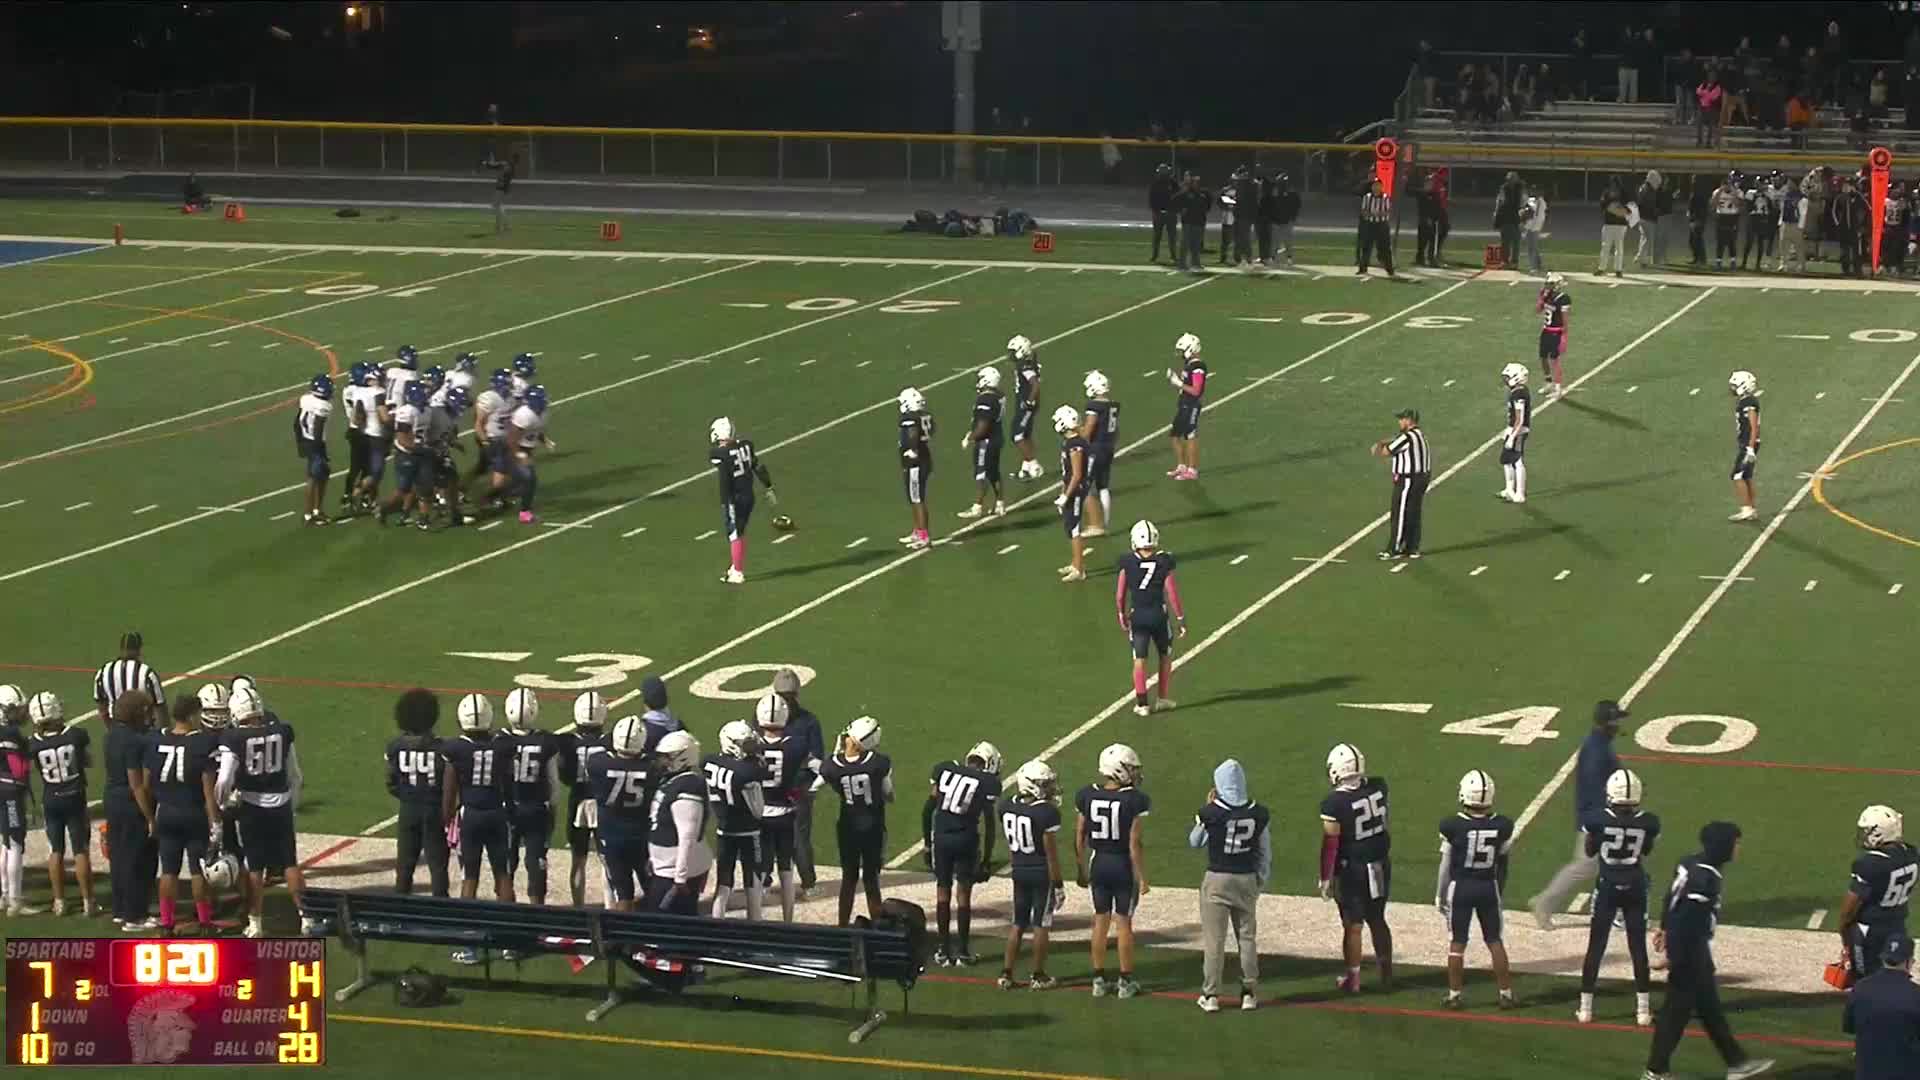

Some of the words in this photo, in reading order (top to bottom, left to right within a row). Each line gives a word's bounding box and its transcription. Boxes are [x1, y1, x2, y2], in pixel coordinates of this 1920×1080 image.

[1034, 233, 1050, 249] 20
[729, 445, 752, 478] 34
[1138, 562, 1156, 590] 7
[158, 745, 185, 783] 71
[245, 734, 282, 776] 60
[399, 751, 435, 787] 44
[472, 750, 494, 786] 11
[606, 769, 648, 808] 75
[704, 761, 735, 806] 24
[840, 773, 873, 805] 19
[938, 769, 980, 814] 40
[1002, 812, 1035, 854] 80
[1090, 799, 1121, 841] 51
[1351, 790, 1388, 841] 25
[1223, 818, 1256, 855] 12
[1464, 829, 1499, 869] 15
[1600, 826, 1646, 866] 23
